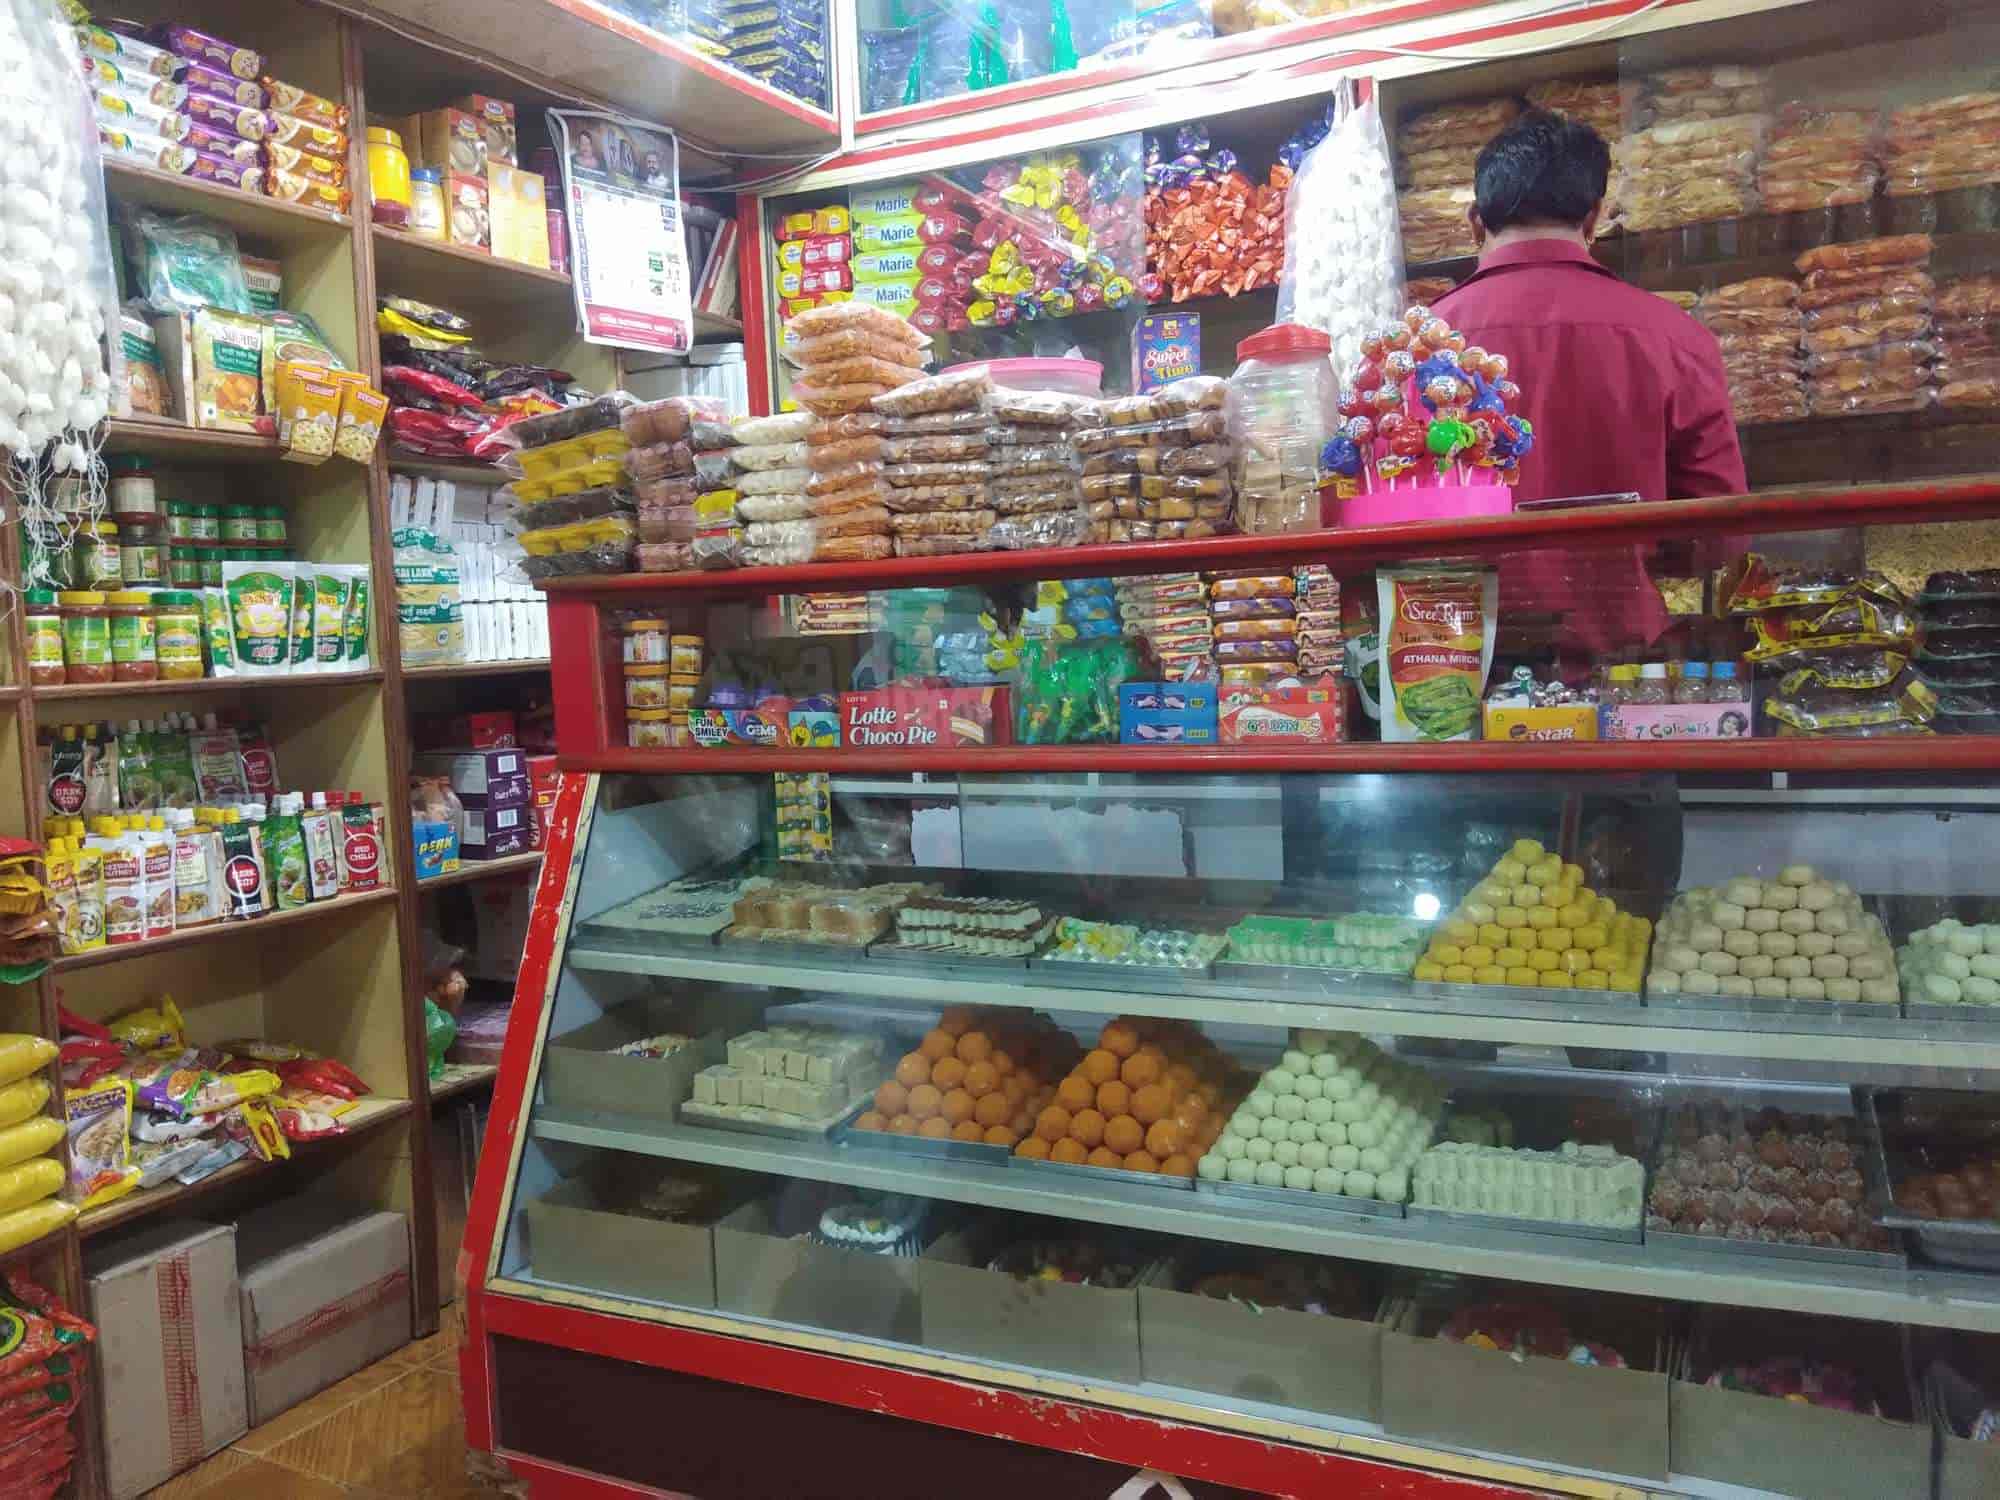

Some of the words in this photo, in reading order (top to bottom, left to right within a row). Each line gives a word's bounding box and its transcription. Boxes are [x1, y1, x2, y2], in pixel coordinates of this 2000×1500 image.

[875, 196, 912, 213] Marie
[880, 225, 915, 242] Marie
[879, 255, 914, 273] Marie
[876, 285, 912, 302] Marie
[1144, 347, 1190, 368] Sweet
[1403, 654, 1447, 665] ATHANA
[695, 719, 713, 728] FUN
[849, 707, 897, 725] Lotte
[695, 727, 729, 738] SMILEY
[849, 727, 905, 745] Choco
[907, 726, 938, 745] Pie
